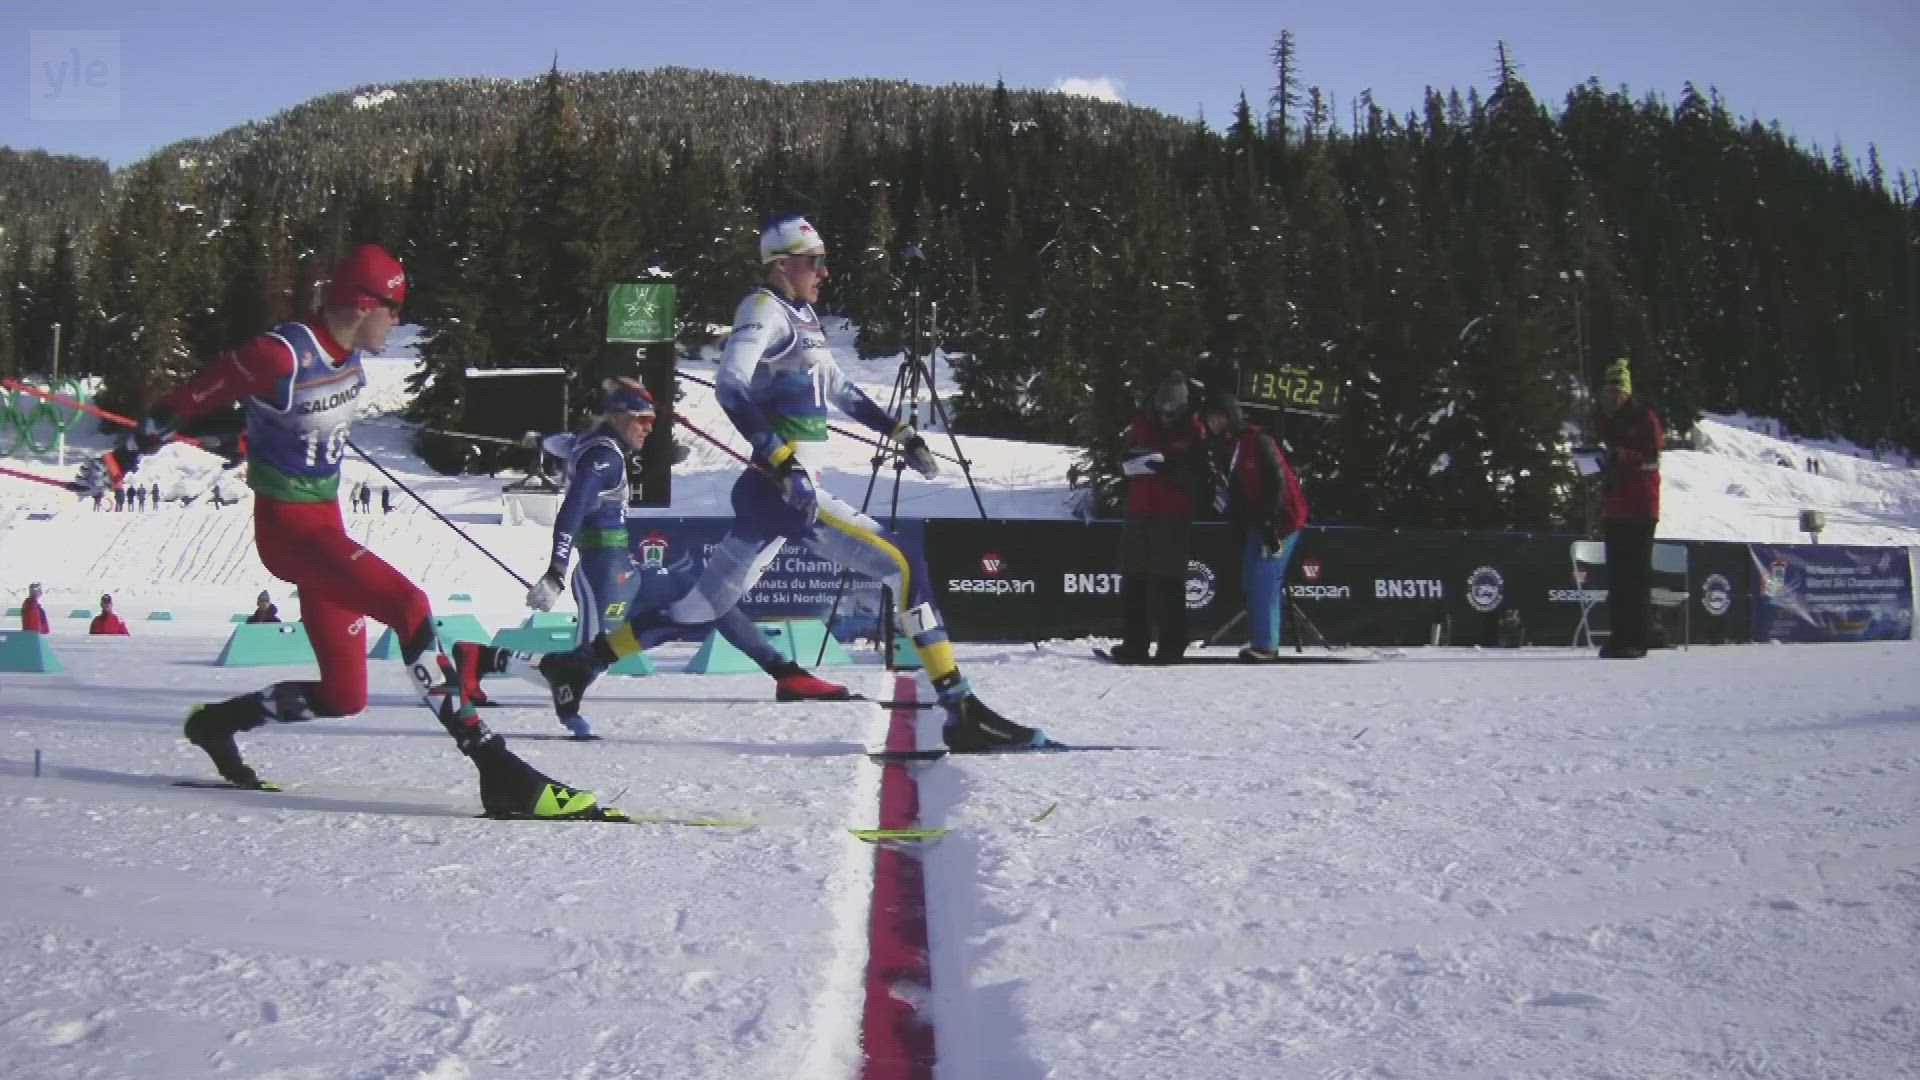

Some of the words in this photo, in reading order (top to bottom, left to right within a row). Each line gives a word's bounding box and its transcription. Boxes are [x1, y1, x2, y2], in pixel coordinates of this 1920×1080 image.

[948, 578, 1036, 596] seaspan
[1063, 573, 1123, 593] BN3T
[1374, 579, 1442, 598] BN3TH
[772, 592, 790, 603] Ski
